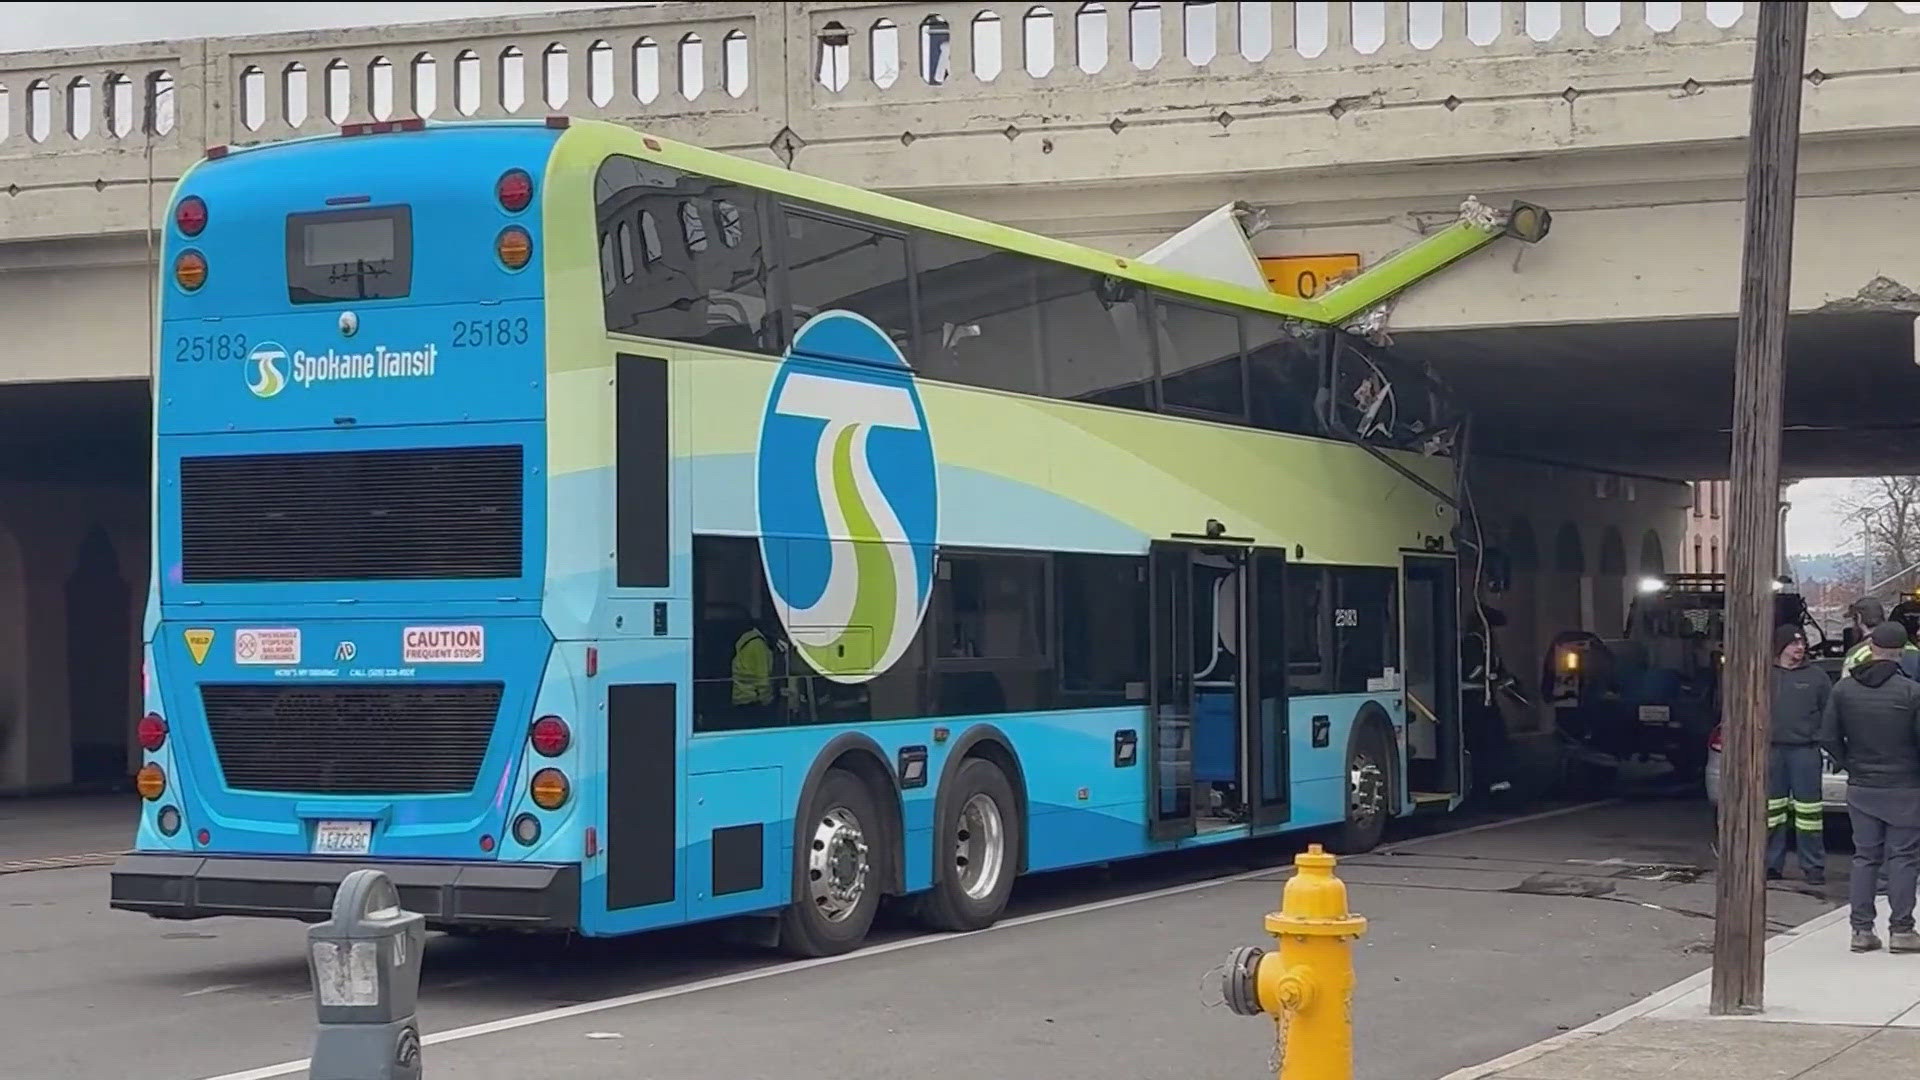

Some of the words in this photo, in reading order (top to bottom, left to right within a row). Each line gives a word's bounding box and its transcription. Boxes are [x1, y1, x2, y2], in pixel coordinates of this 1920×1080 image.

[452, 317, 529, 347] 25183
[176, 333, 248, 362] 25183
[293, 348, 375, 388] Spokane
[376, 343, 438, 378] Transit
[407, 631, 481, 647] CAUTION
[406, 648, 452, 660] FREQUENT
[454, 648, 482, 658] STOPS
